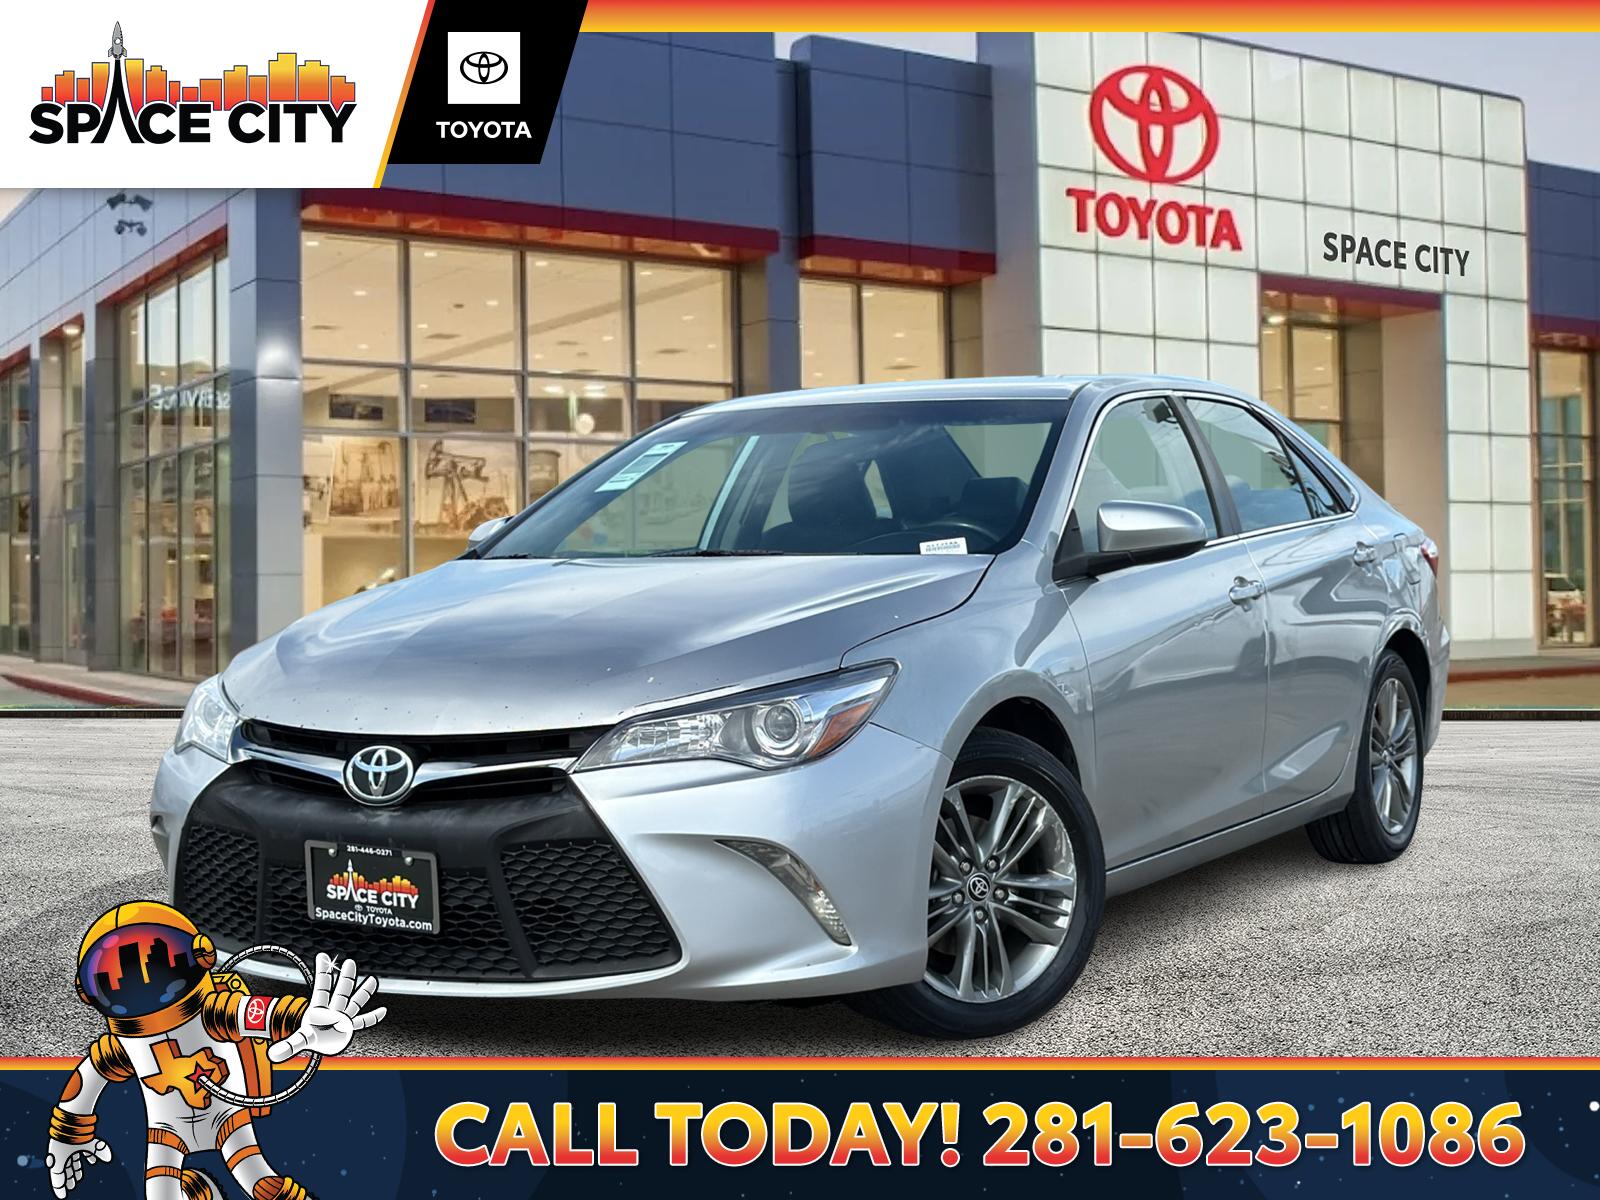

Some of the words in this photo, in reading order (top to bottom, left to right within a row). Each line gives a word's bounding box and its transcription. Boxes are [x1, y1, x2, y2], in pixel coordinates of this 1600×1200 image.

[1066, 188, 1242, 251] TOYOTA
[1322, 231, 1407, 270] SPACE
[1414, 245, 1471, 277] CITY
[346, 845, 393, 857] 281-446-0271
[326, 880, 379, 905] SPACE
[381, 891, 420, 909] CITY
[315, 907, 433, 931] SpaceCityToyota.com
[366, 906, 393, 915] TOYOTA
